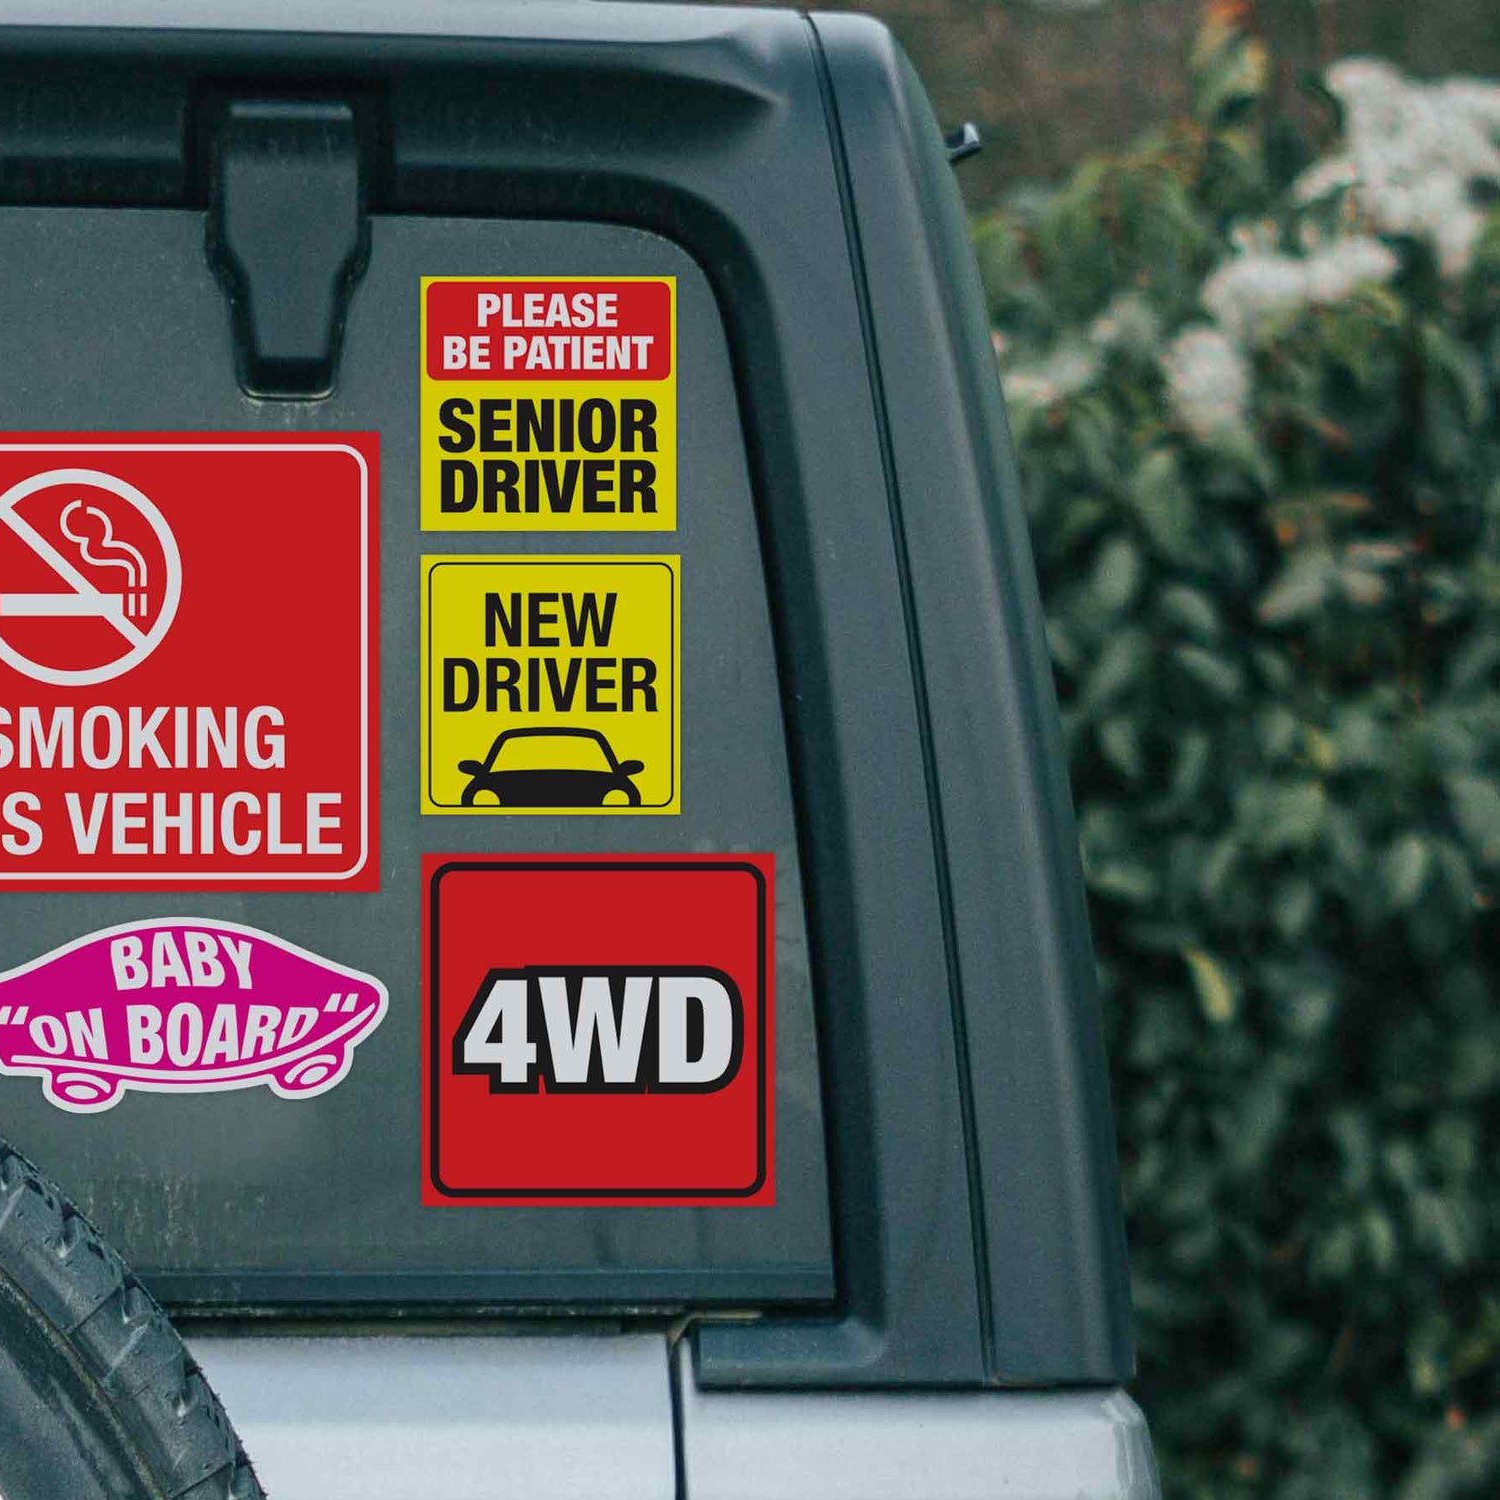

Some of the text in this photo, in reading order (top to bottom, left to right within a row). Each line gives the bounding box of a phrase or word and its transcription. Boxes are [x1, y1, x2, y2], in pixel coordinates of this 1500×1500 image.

[478, 293, 617, 327] PLEASE
[444, 336, 653, 369] BE PATIENT
[439, 398, 658, 453] SENIOR
[441, 460, 657, 513] DRIVER
[486, 593, 617, 647] NEW
[444, 658, 658, 712] DRIVER
[65, 792, 342, 855] VEHICLE
[110, 931, 253, 990] BABY
[464, 977, 732, 1082] 4WD
